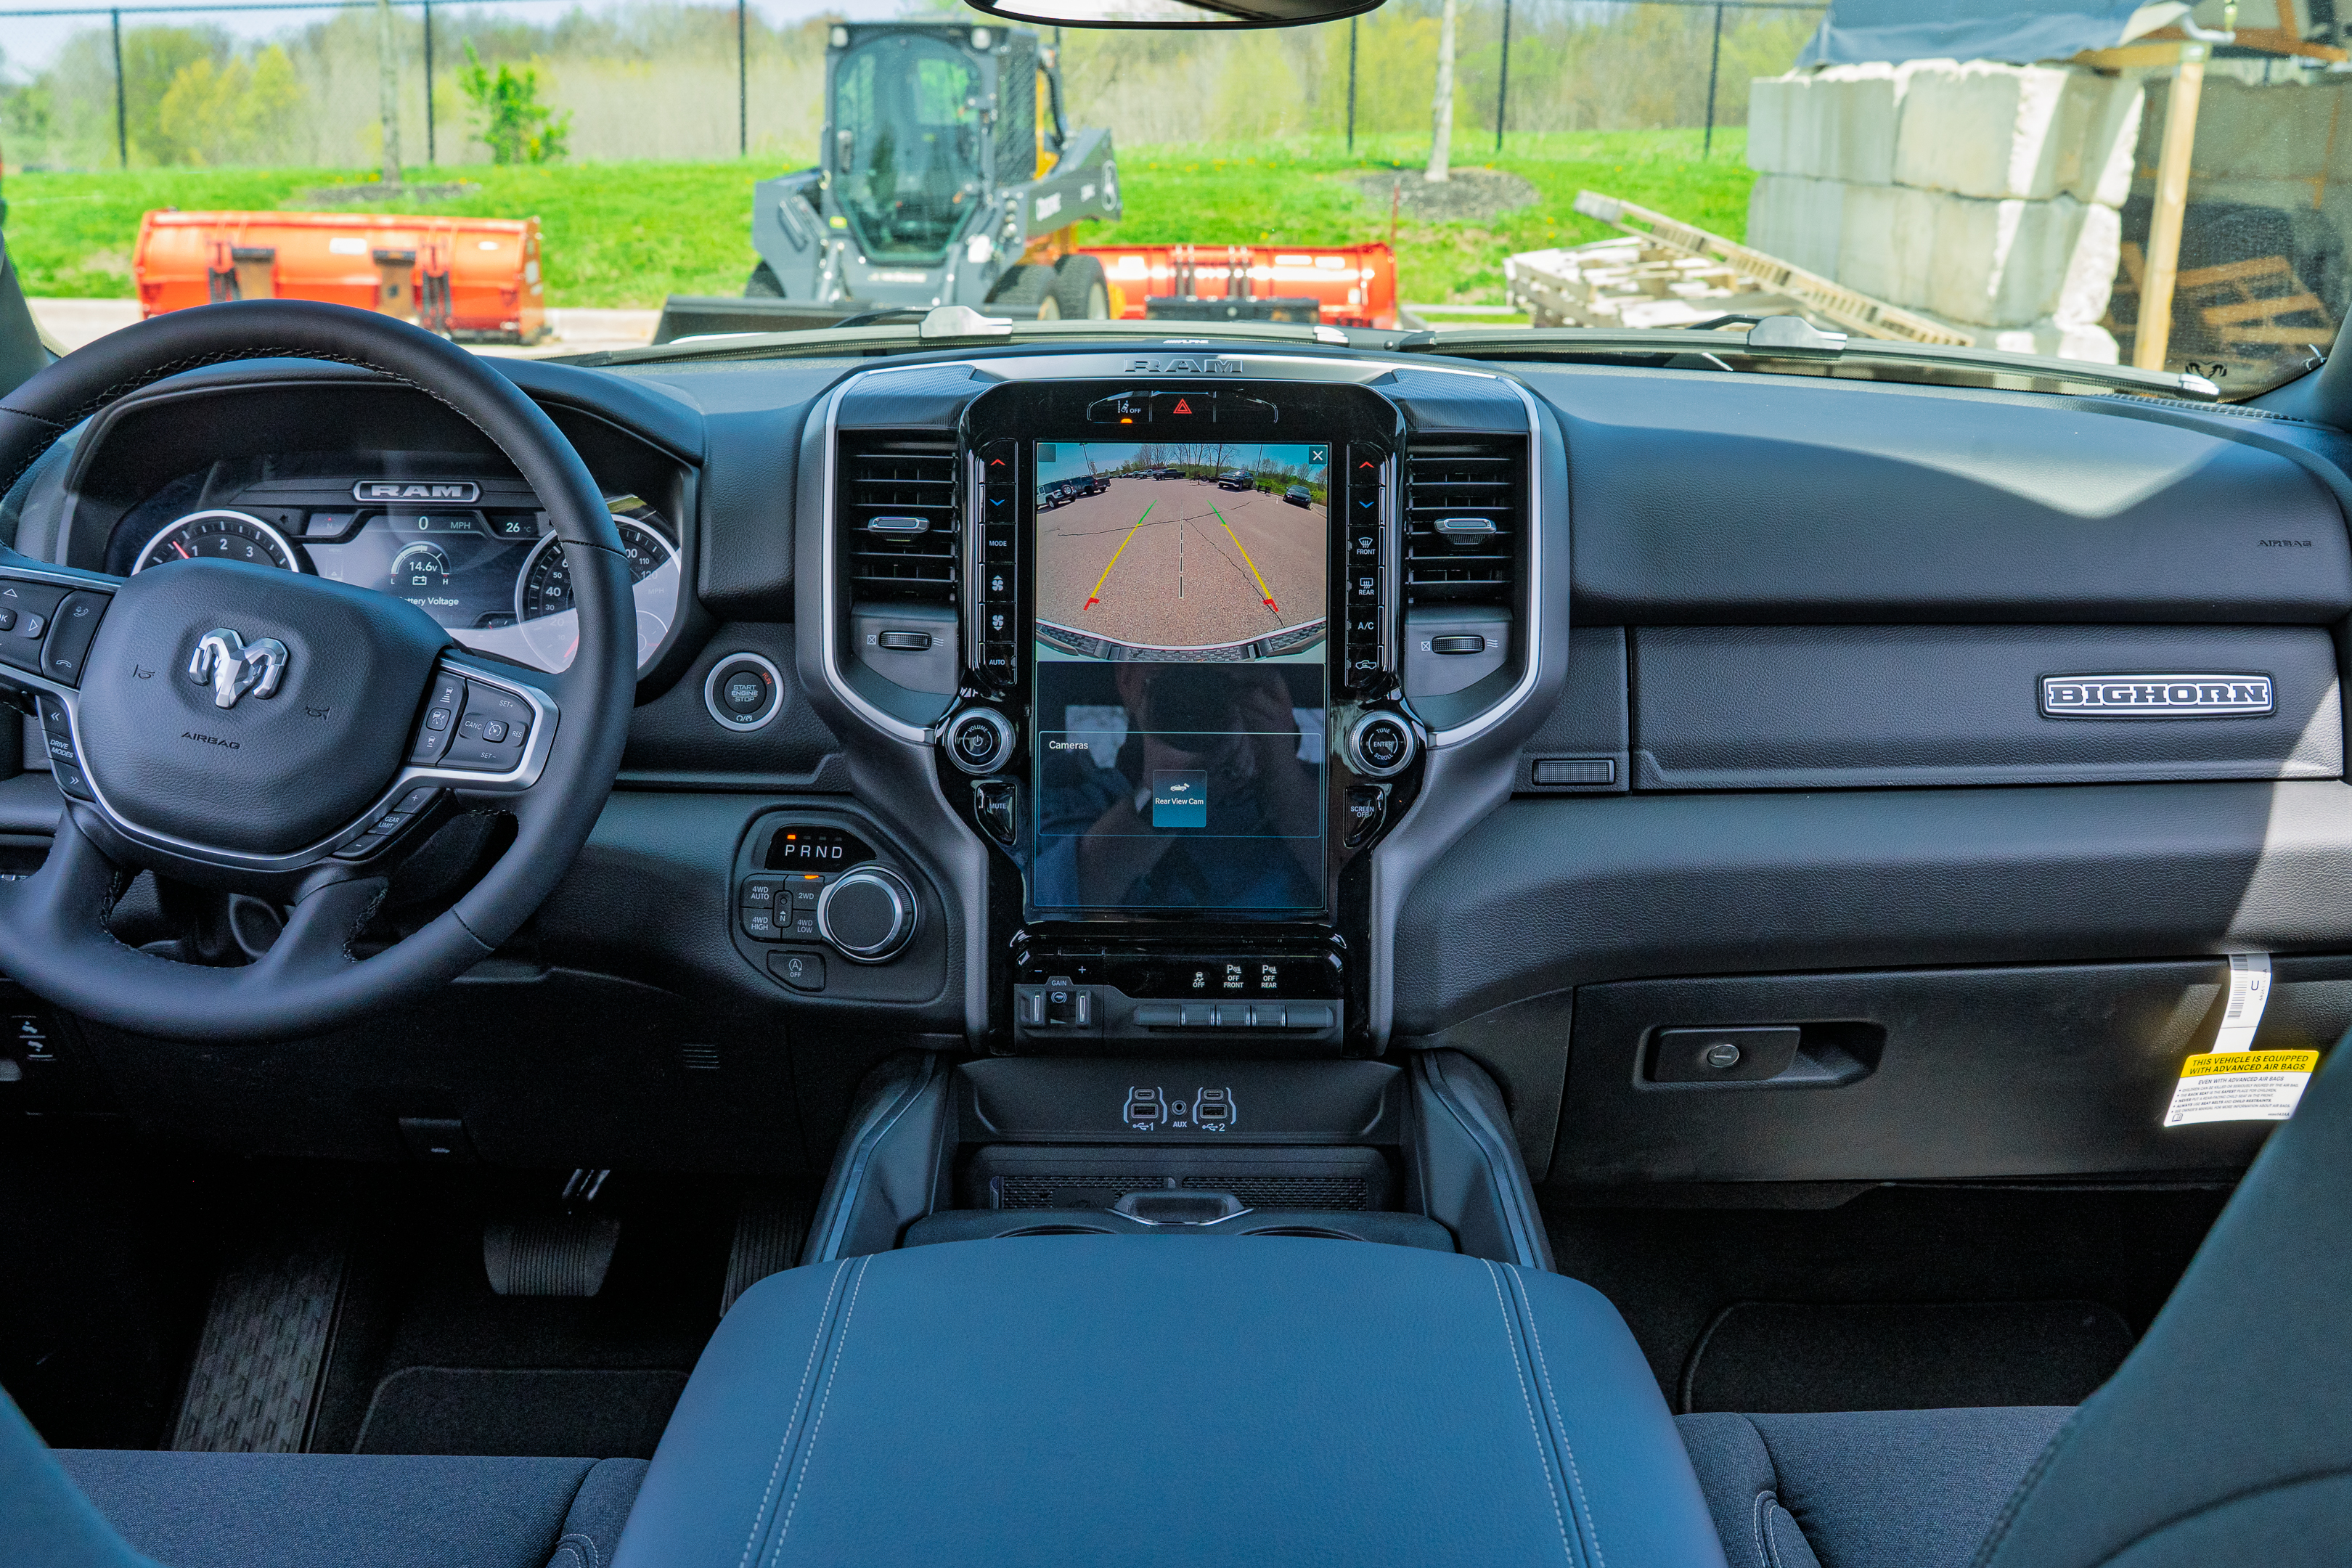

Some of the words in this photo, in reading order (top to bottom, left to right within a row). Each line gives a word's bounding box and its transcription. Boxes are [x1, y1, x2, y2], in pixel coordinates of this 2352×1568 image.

[1124, 359, 1243, 373] RAM
[371, 485, 462, 498] RAM
[418, 516, 428, 530] 0
[505, 522, 520, 533] 26
[220, 539, 227, 550] 2
[192, 545, 198, 556] 1
[246, 546, 253, 557] 3
[641, 571, 658, 580] 120
[546, 587, 561, 597] 40
[399, 596, 426, 607] ttery
[428, 596, 460, 607] Voltage
[550, 617, 565, 627] 20
[762, 672, 772, 685] RUN
[2049, 683, 2269, 706] BIGHORN
[465, 720, 482, 730] CANC
[967, 724, 989, 733] VOLUME
[512, 730, 522, 738] RES
[49, 739, 69, 750] DRIVE
[181, 732, 241, 750] AIRBAG
[1049, 740, 1088, 749] Cameras
[51, 747, 73, 759] MODES
[2213, 1064, 2261, 1073] ADVANCED
